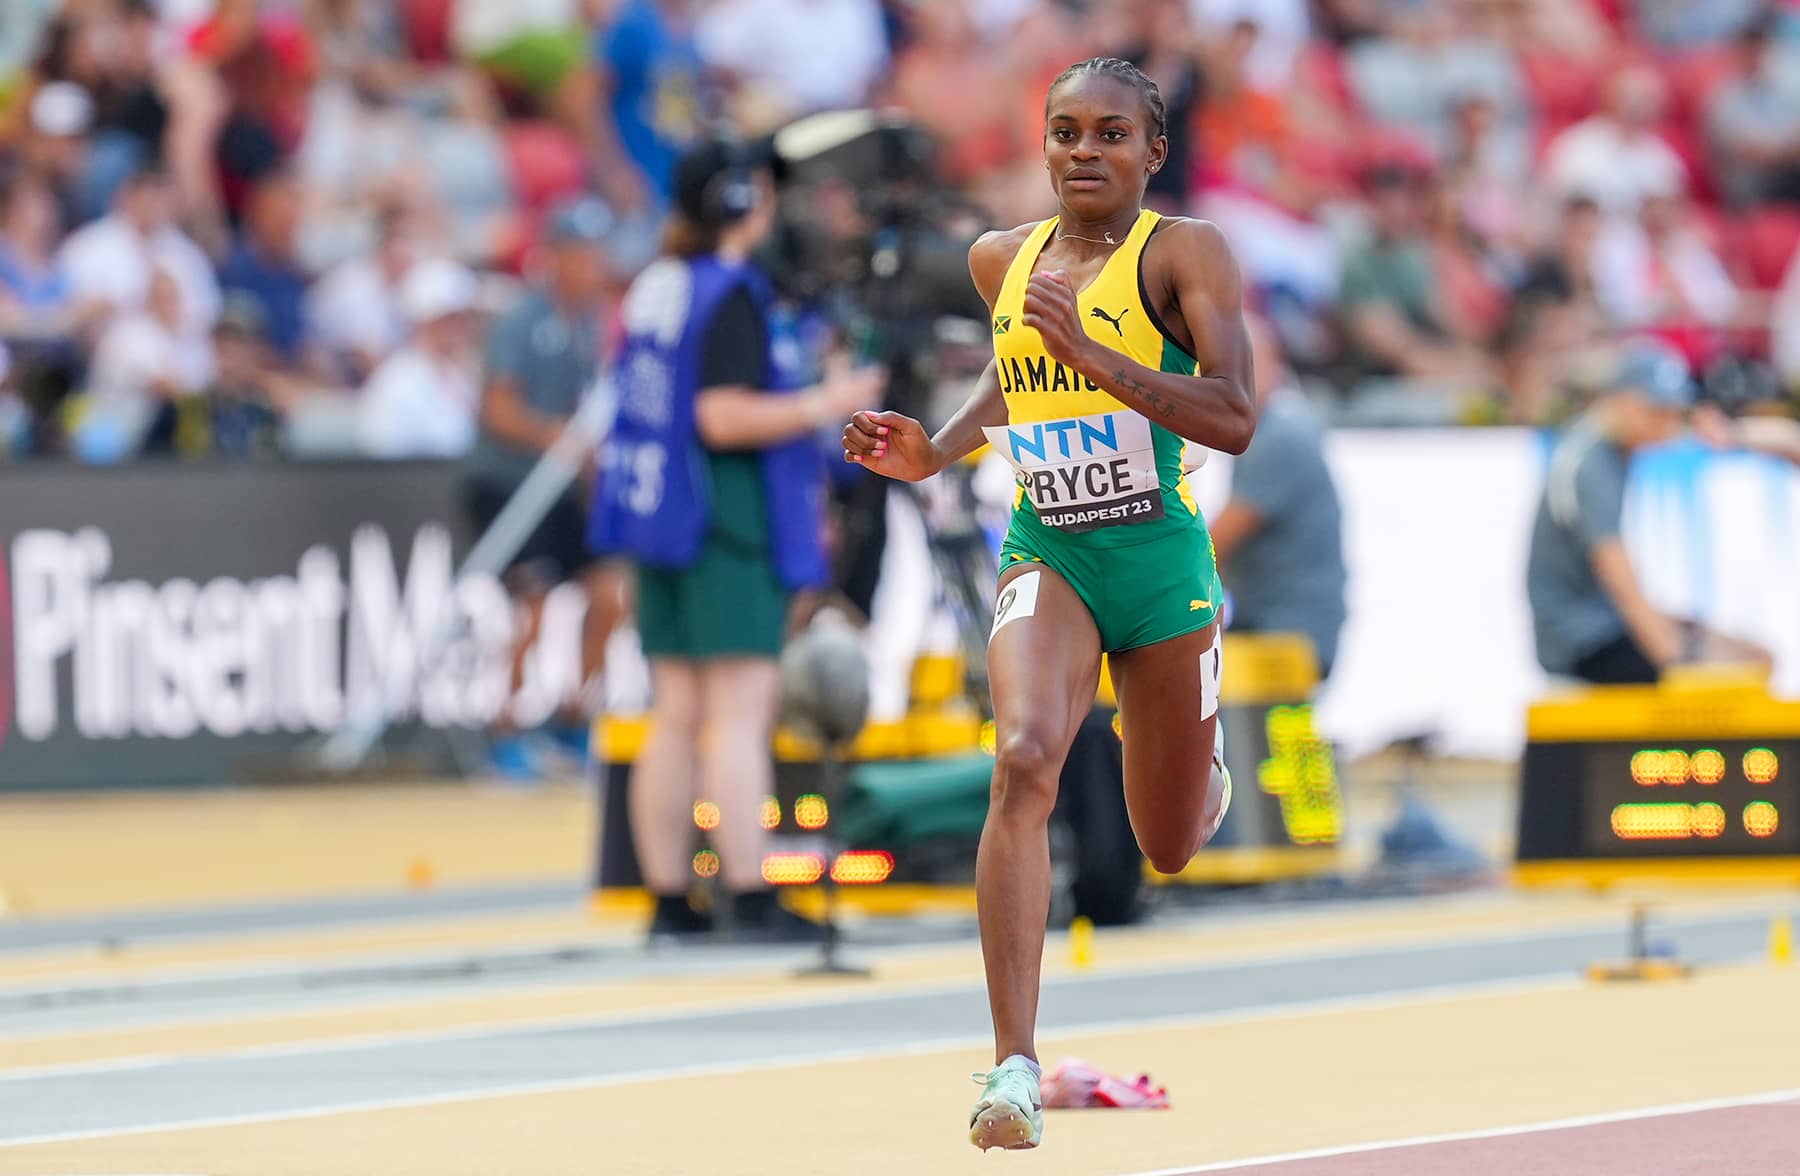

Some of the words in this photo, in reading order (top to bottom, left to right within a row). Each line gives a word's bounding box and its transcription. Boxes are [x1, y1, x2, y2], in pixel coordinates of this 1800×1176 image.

[1008, 415, 1118, 464] NTN
[1041, 504, 1129, 527] BUDAPEST
[1131, 499, 1152, 515] 23
[997, 588, 1017, 625] 9
